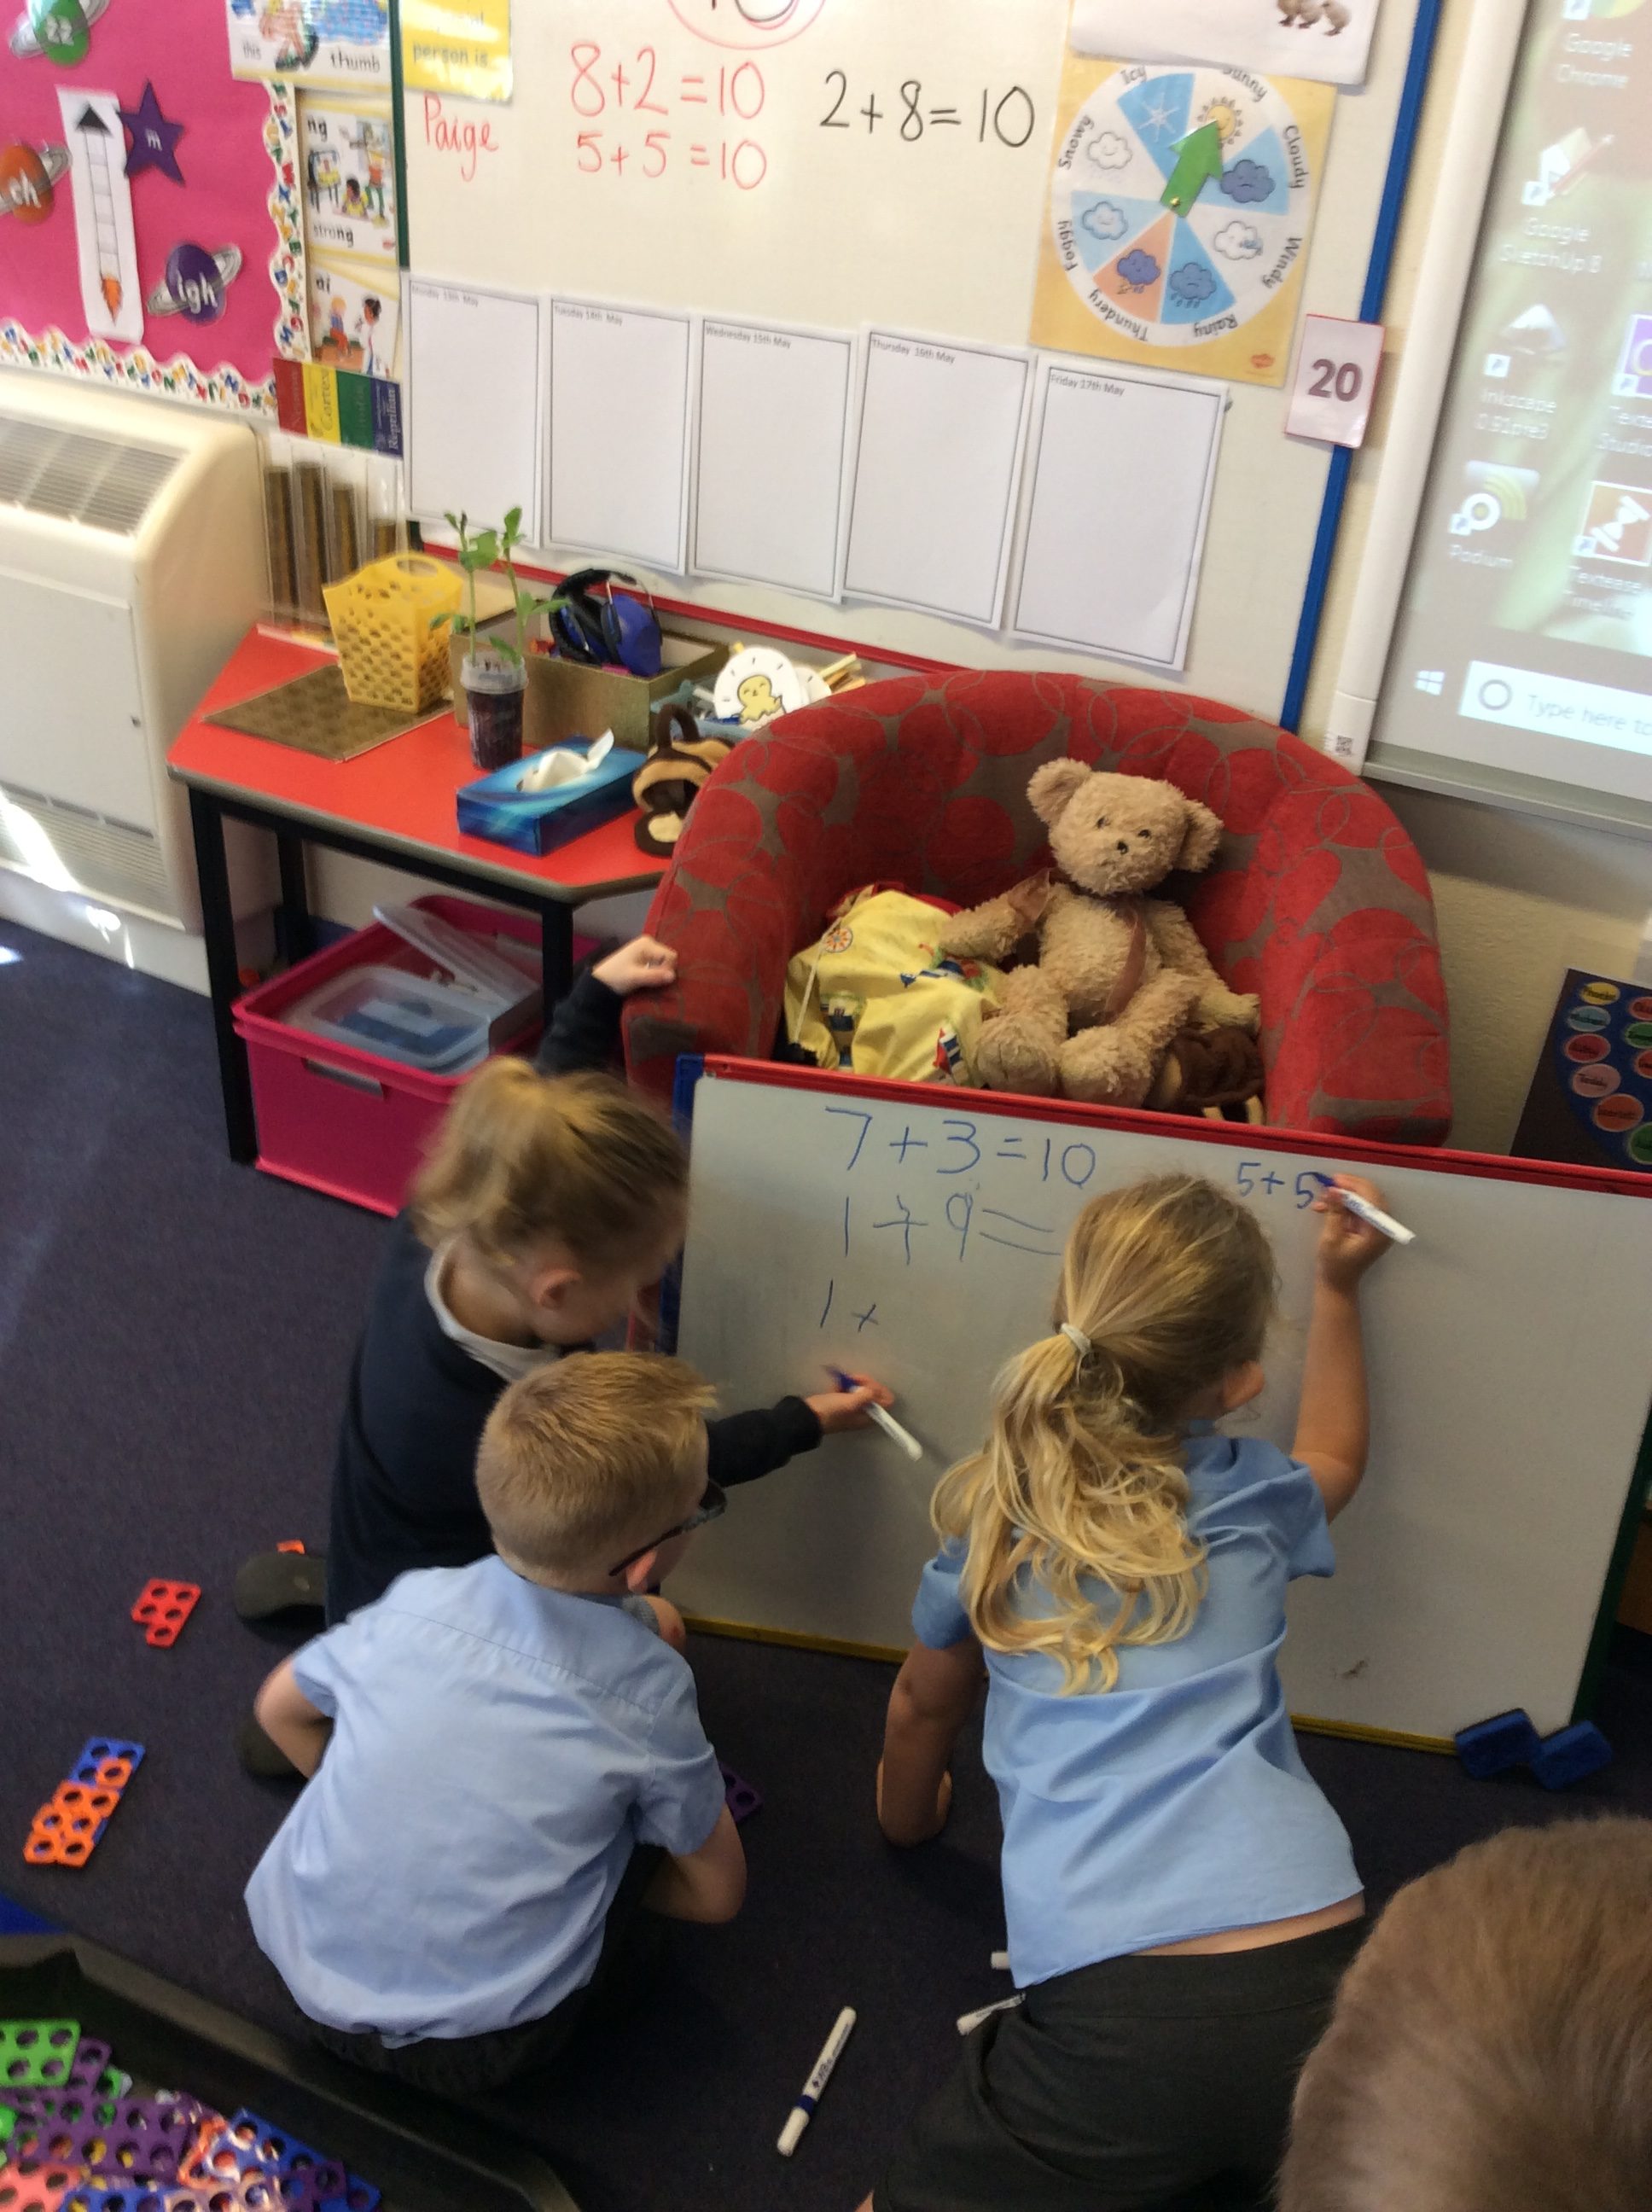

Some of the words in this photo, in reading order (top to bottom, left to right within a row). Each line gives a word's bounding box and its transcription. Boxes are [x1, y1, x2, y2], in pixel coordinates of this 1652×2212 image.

[242, 40, 262, 60] this
[330, 48, 381, 73] thumb
[413, 42, 468, 65] person
[474, 48, 489, 68] is
[1565, 32, 1632, 61] Google
[1120, 64, 1148, 84] Icy
[307, 115, 328, 143] ng
[424, 90, 499, 183] Paige
[1058, 114, 1095, 170] Snowy
[1283, 125, 1310, 189] Cloudy
[9, 168, 42, 208] ch
[313, 223, 354, 248] strong
[1525, 217, 1591, 245] Google
[1057, 220, 1079, 272] Foggy
[1261, 236, 1303, 288] Windy
[176, 268, 218, 314] igh
[316, 274, 331, 294] ai
[555, 305, 584, 321] Tuesday
[607, 313, 623, 327] May
[1088, 288, 1149, 342] Thundery
[1194, 313, 1239, 338] Rainy
[706, 325, 752, 345] Wednesday
[774, 336, 792, 350] May
[871, 338, 910, 356] Thursday
[937, 350, 956, 365] May
[1050, 374, 1079, 390] Friday
[1080, 379, 1101, 392] 17th
[1104, 382, 1126, 397] May
[1307, 358, 1364, 402] 20
[1448, 544, 1514, 569] Podium
[1528, 694, 1575, 719] Type
[1584, 707, 1627, 731] here
